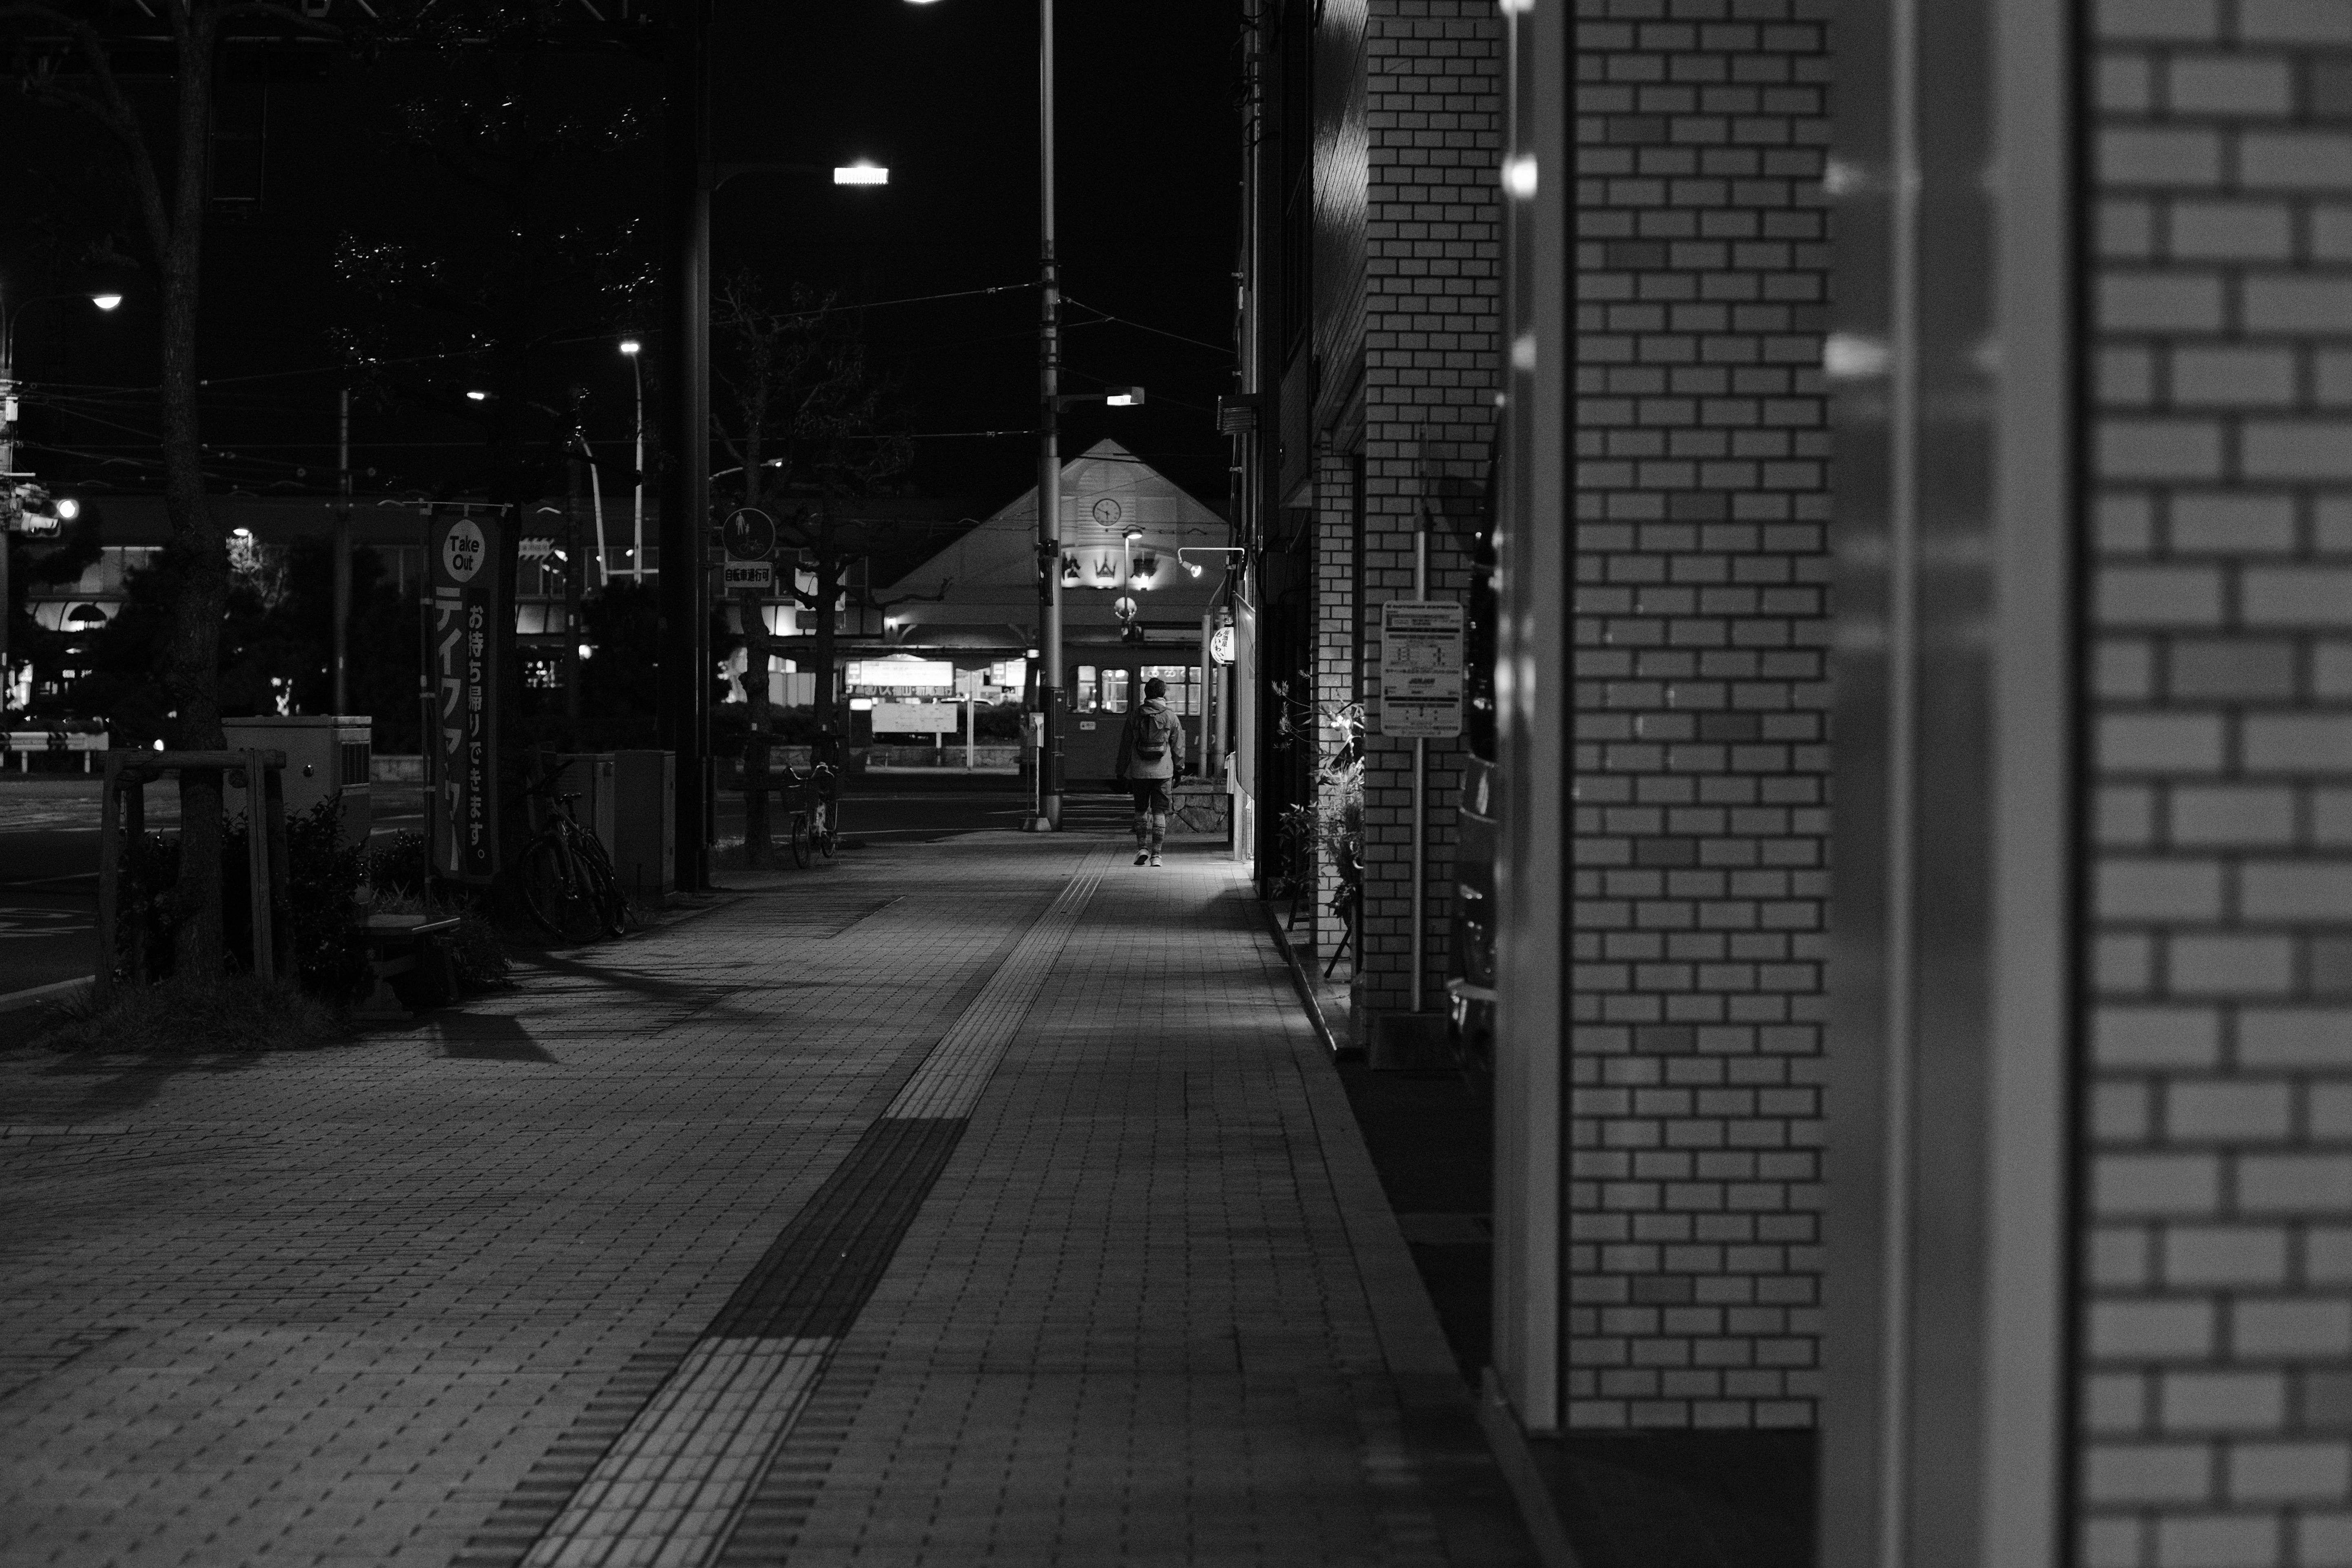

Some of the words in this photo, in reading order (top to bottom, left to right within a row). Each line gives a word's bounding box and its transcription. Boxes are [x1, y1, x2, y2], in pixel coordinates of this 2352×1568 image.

[450, 535, 479, 552] Take
[452, 554, 473, 571] Out
[726, 569, 768, 581] 自転車通行可
[1222, 630, 1230, 647] 居酒屋
[468, 605, 485, 859] お持ち帰りできます。
